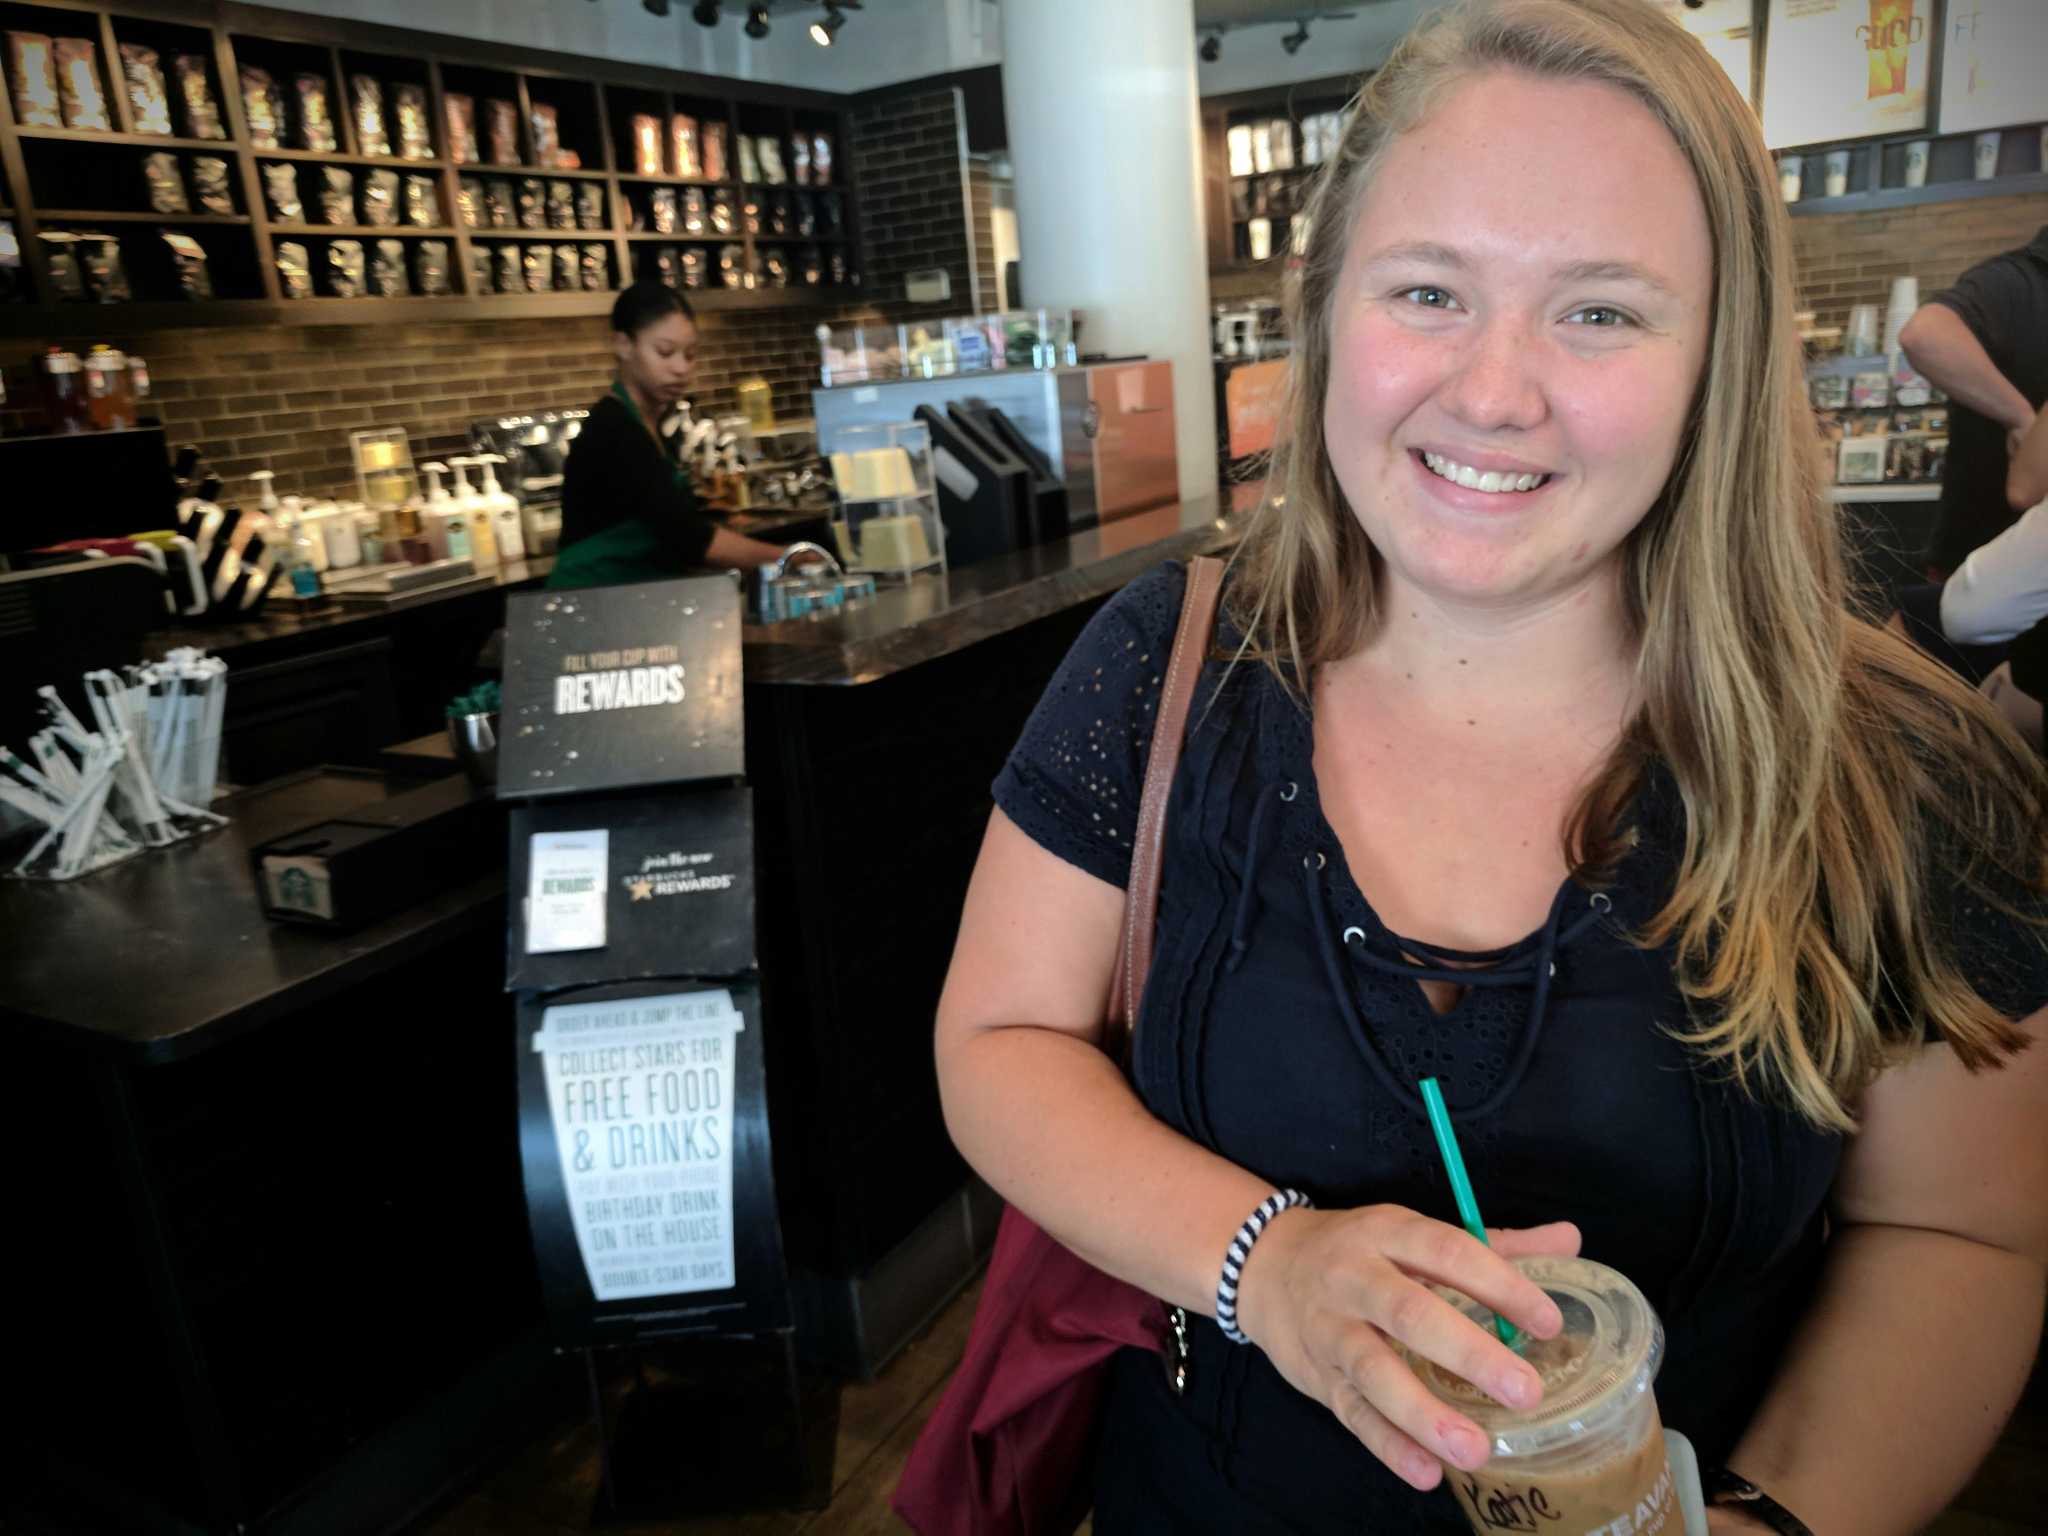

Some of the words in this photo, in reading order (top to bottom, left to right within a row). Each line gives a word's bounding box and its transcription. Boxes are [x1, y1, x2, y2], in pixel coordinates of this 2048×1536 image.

[565, 655, 587, 672] FILL
[590, 651, 620, 669] YOUR
[623, 648, 646, 666] CUP
[649, 645, 677, 662] WITH
[556, 665, 685, 714] REWARDS
[560, 1048, 627, 1076] COLLECT
[634, 1041, 687, 1069] STARS
[691, 1036, 722, 1063] FOR
[564, 1076, 633, 1124] FREE
[648, 1067, 721, 1116] FOOD
[573, 1128, 595, 1173] &
[609, 1115, 721, 1170] DRINKS
[586, 1193, 664, 1224] BIRTHDAY
[671, 1189, 721, 1215] DRINK
[591, 1226, 617, 1252] ON
[622, 1221, 655, 1247] THE
[664, 1216, 721, 1245] HOUSE
